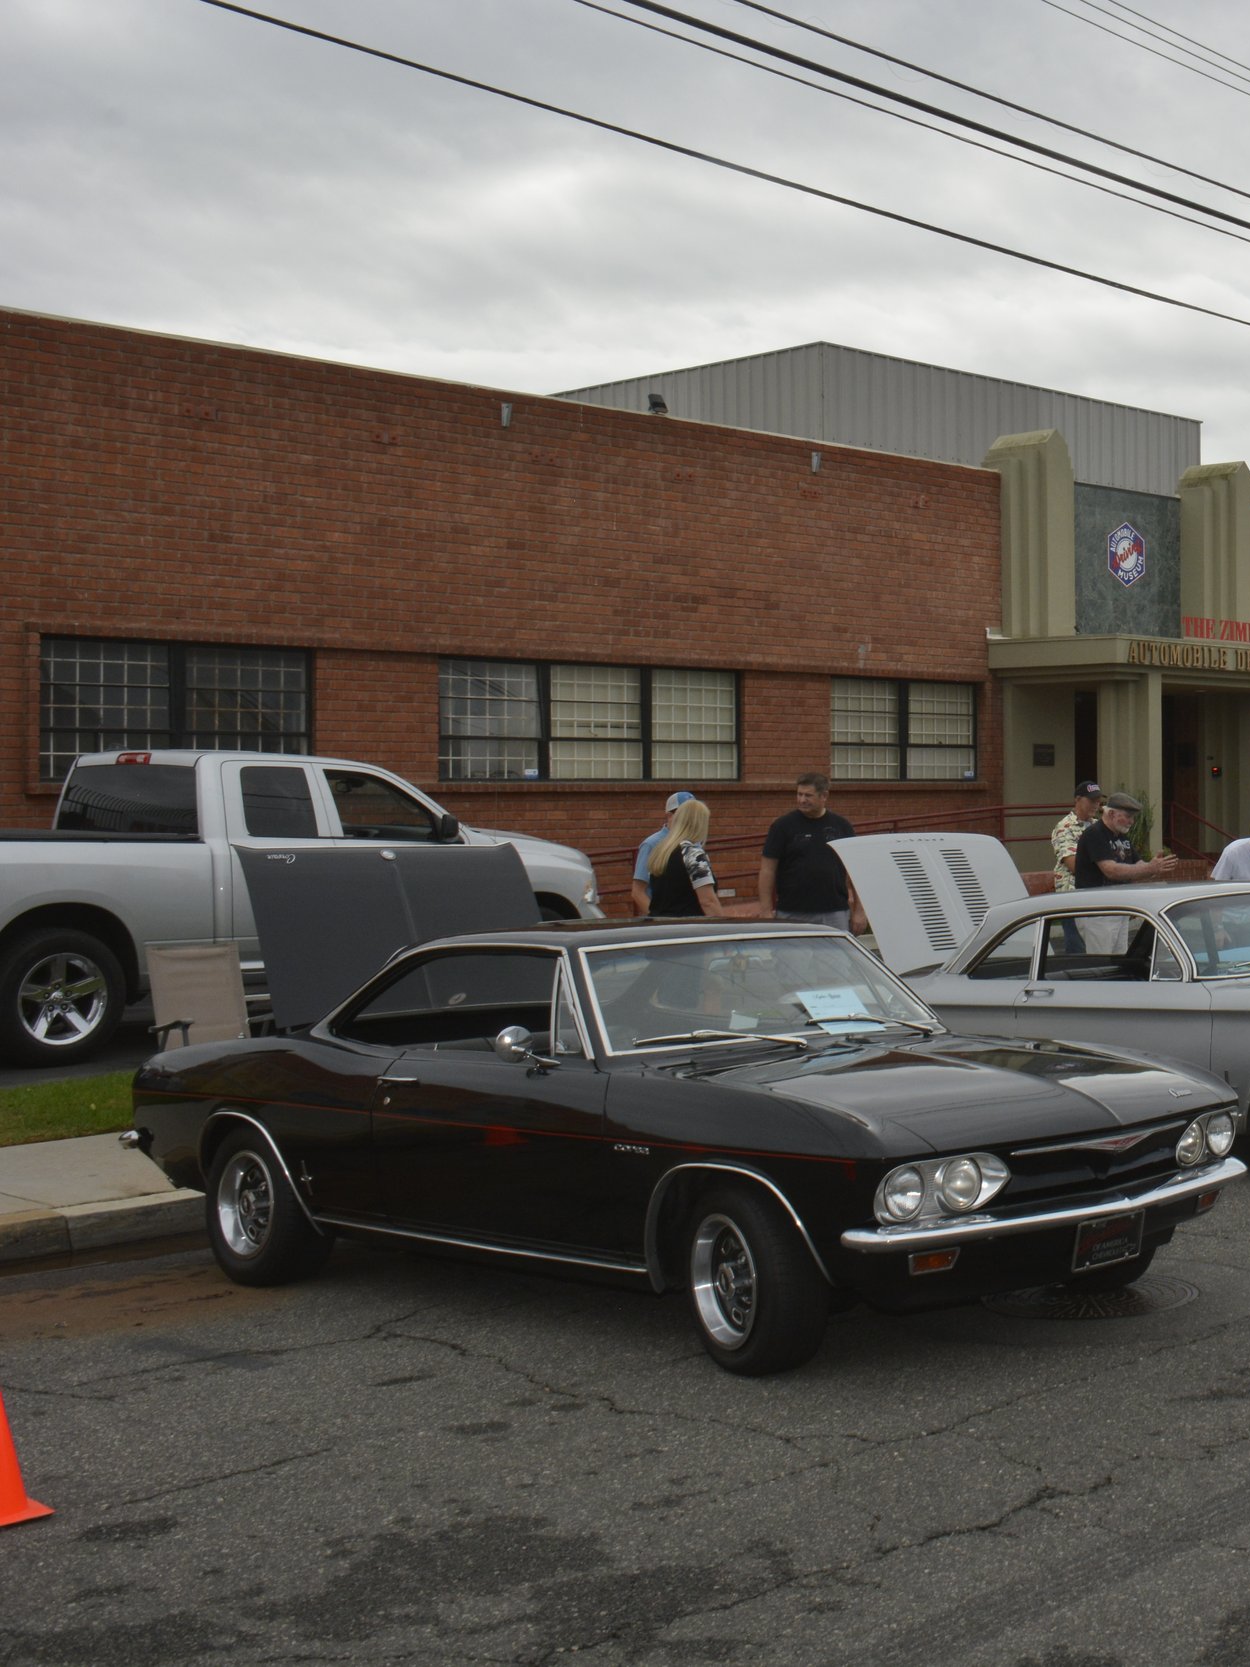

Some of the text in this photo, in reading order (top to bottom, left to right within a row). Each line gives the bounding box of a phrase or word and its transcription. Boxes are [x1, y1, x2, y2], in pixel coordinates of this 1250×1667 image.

[1117, 556, 1145, 580] MUSEUM
[1182, 616, 1216, 640] THE
[1127, 640, 1228, 670] AUTOMOBILE
